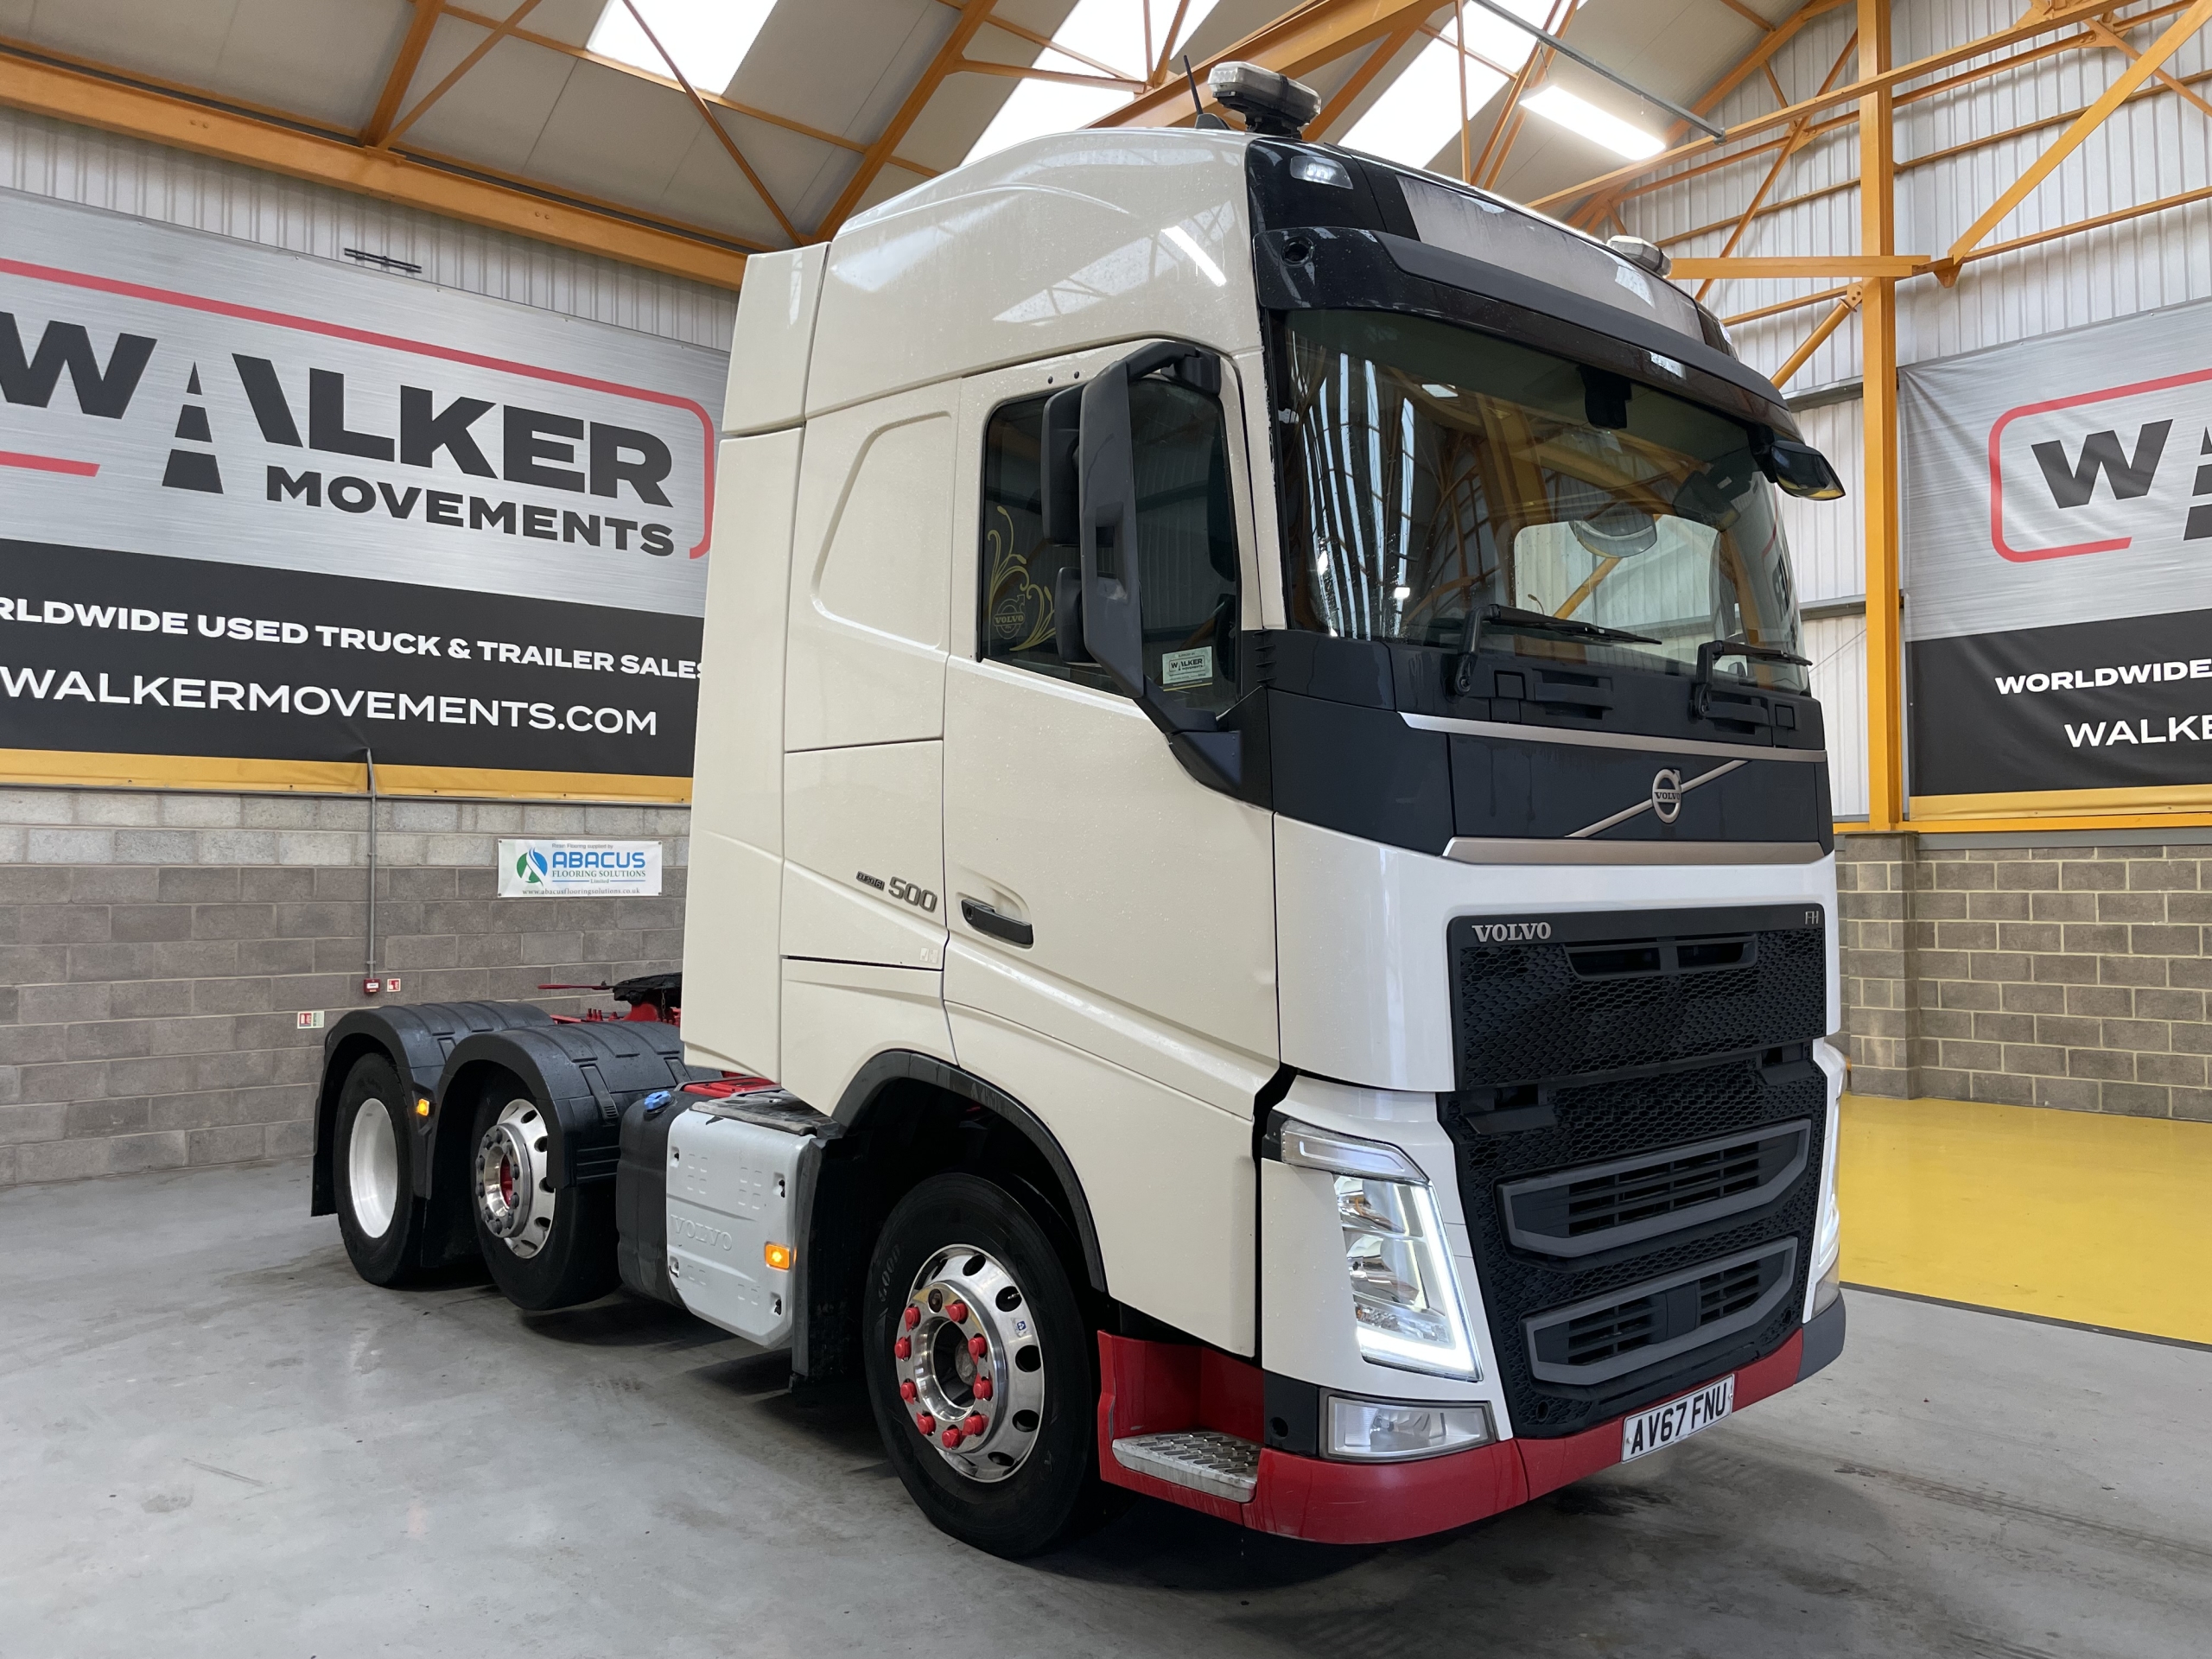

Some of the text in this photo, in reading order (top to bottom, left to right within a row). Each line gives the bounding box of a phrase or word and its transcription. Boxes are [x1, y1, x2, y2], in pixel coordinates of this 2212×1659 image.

[0, 312, 674, 508] WALKER
[2031, 419, 2212, 541] W
[267, 466, 675, 556] MOVEMENTS
[995, 615, 1024, 625] VOLVO
[197, 614, 309, 645] USED
[315, 625, 442, 658] TRUCK
[447, 638, 472, 659] &
[477, 640, 614, 672] TRAILER
[620, 654, 702, 680] SALE
[1170, 658, 1204, 671] WALKER
[1994, 658, 2212, 695] WORLDWIDE
[0, 665, 657, 736] WALKERMOVEMENTS.COM
[1654, 791, 1681, 800] VOLVO
[551, 869, 646, 878] FLOORING SOLUTIONS
[552, 851, 646, 868] ABACUS
[887, 876, 938, 913] 500
[1471, 921, 1552, 943] VOLVO
[671, 1213, 733, 1251] VOLVO
[1630, 1382, 1727, 1455] AV67 FNU
